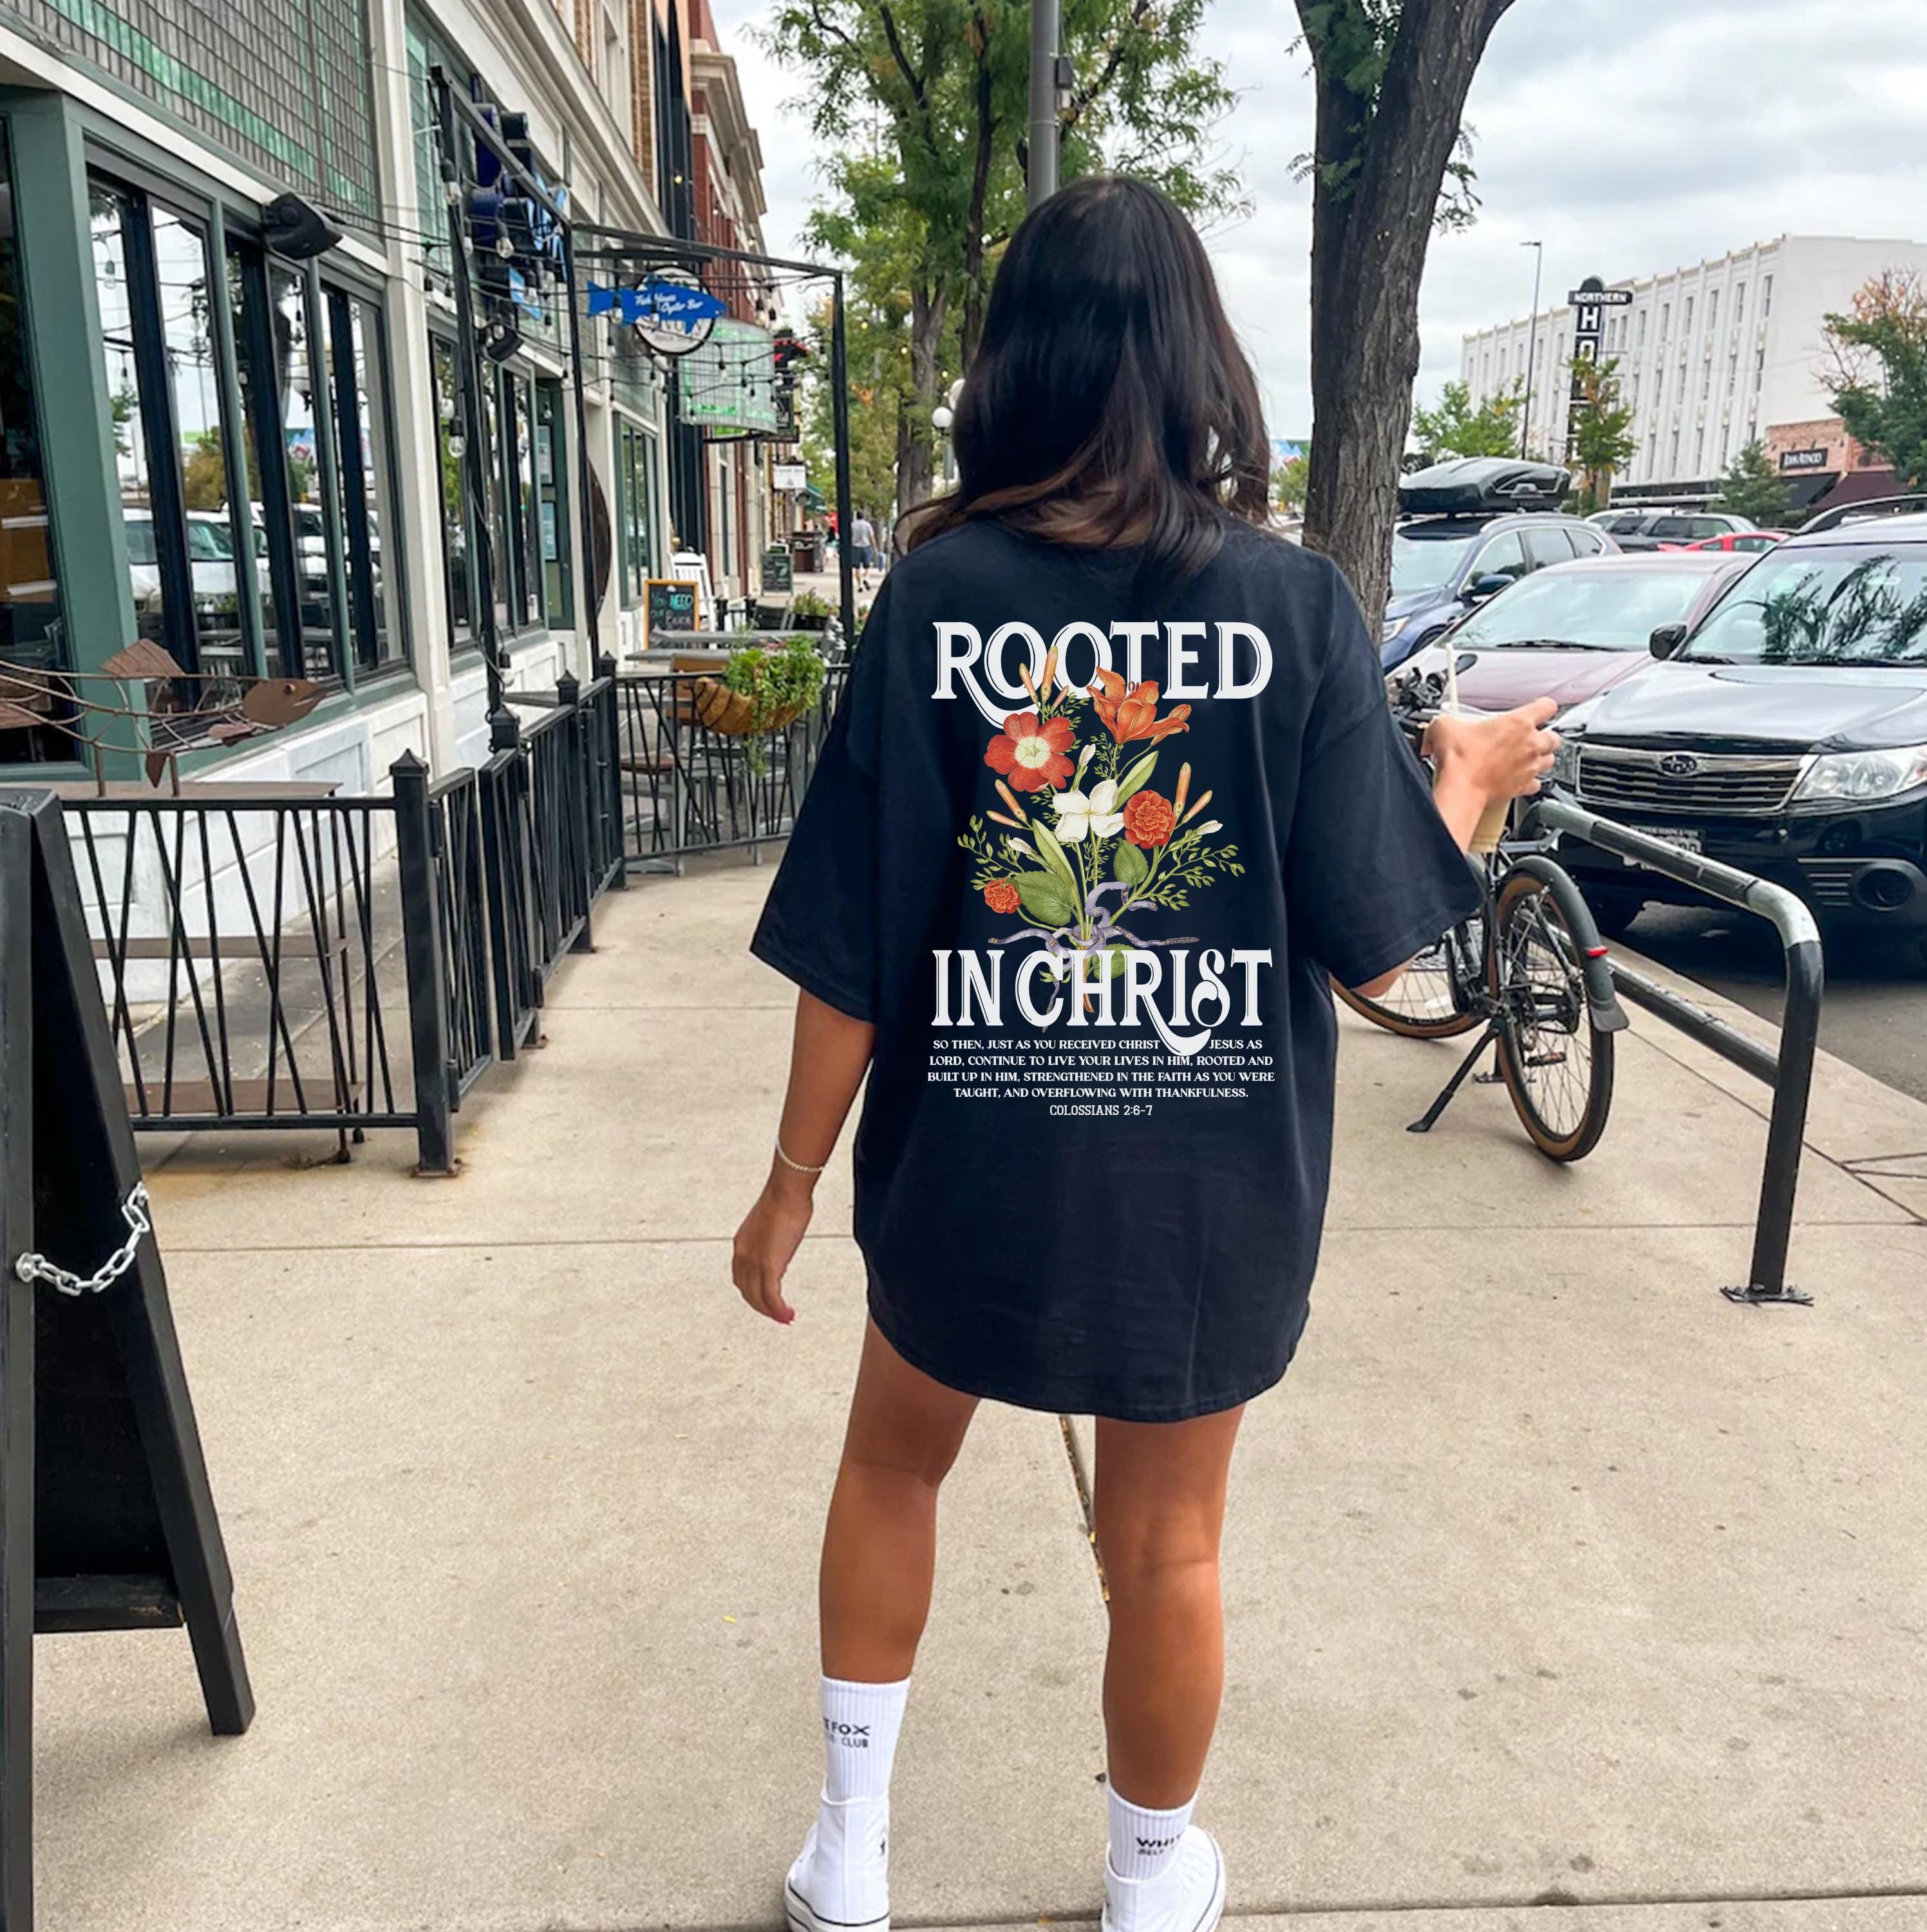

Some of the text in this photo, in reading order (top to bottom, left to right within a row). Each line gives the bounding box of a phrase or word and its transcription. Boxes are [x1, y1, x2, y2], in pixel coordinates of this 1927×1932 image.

[1575, 292, 1628, 303] NORTHERN
[670, 594, 693, 609] NEED
[931, 621, 1274, 729] ROOTED
[931, 949, 1273, 1056] IN CHRIST
[933, 1039, 1263, 1050] SO THEN, JUST AS YOU RECEIVED CHRIST JESUS AS
[930, 1056, 1274, 1066] LORD, CONTINUE TO LIVE YOUR LIVES IN HIM, ROOTED AND
[928, 1072, 1275, 1083] BUILT UP IN HIM, STRENGTHENED IN THE FAITH AS YOU WERE
[954, 1088, 1248, 1098] TAUGHT, AND OVERFLOWING WITH THANKFULNESS.
[1049, 1105, 1152, 1115] COLOSSIANS 2:6-7
[831, 1721, 870, 1736] FOX
[841, 1736, 868, 1748] CLUB
